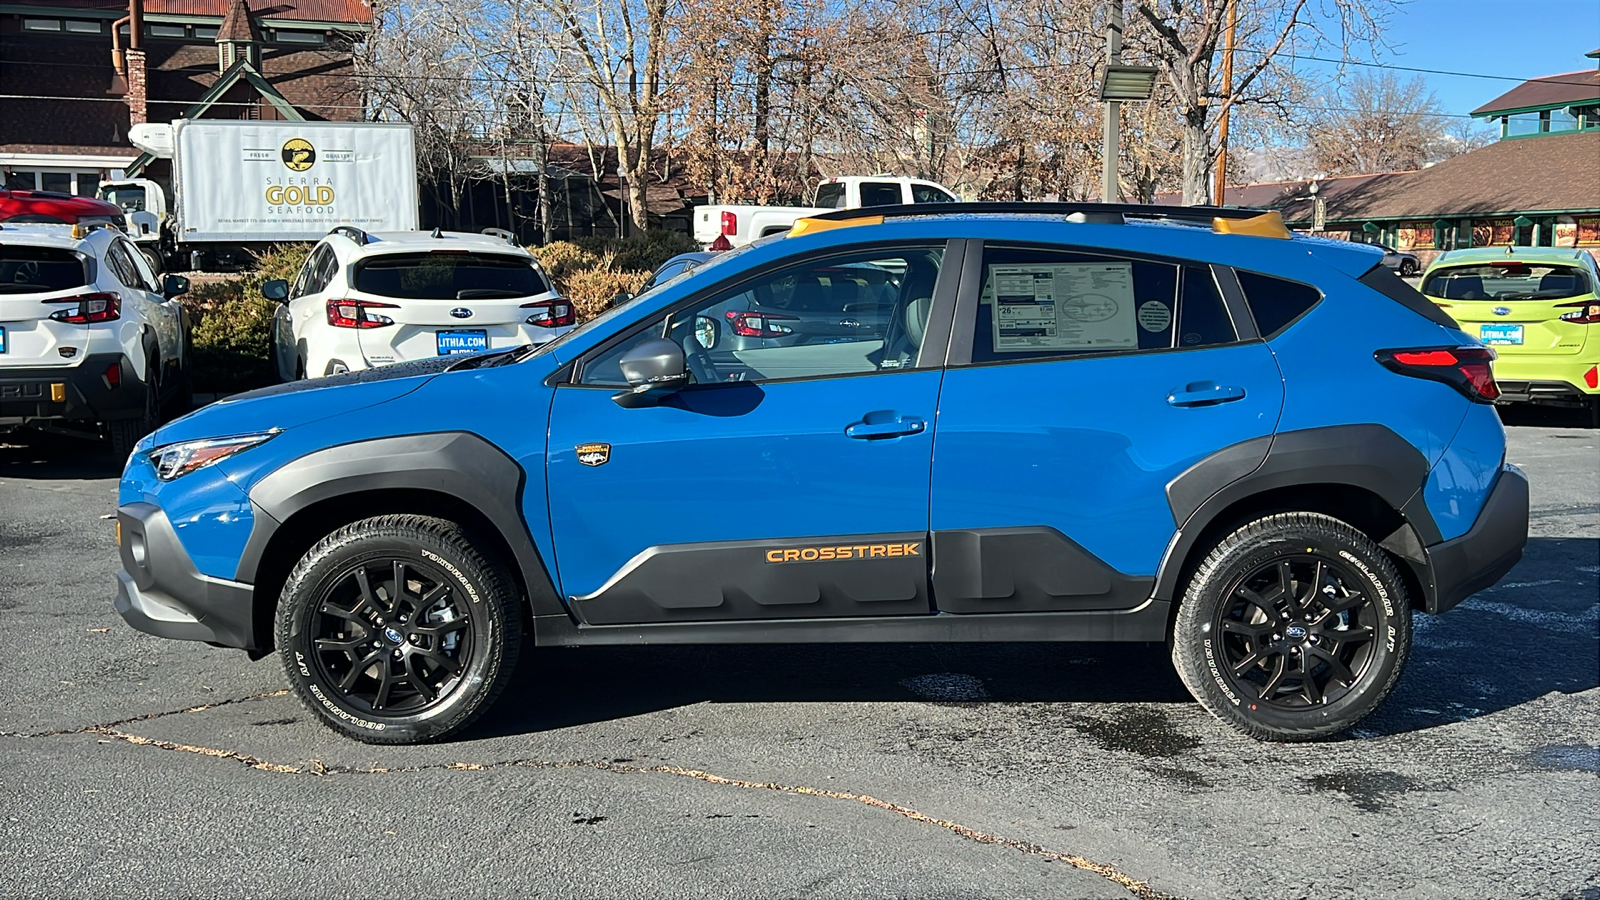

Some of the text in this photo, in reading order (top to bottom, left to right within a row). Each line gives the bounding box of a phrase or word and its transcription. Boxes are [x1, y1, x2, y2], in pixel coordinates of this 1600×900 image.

[266, 177, 333, 185] SIERRA
[265, 185, 335, 206] GOLD
[267, 206, 334, 214] SEAFOOD
[438, 337, 486, 348] LITHIA.COM
[766, 543, 921, 562] CROSSTREK
[421, 549, 480, 604] YOKOHAMA
[1339, 550, 1394, 617] GEOLANDAR
[1204, 639, 1241, 706] YOKOHAMA
[309, 684, 386, 731] GEOLANDAR
